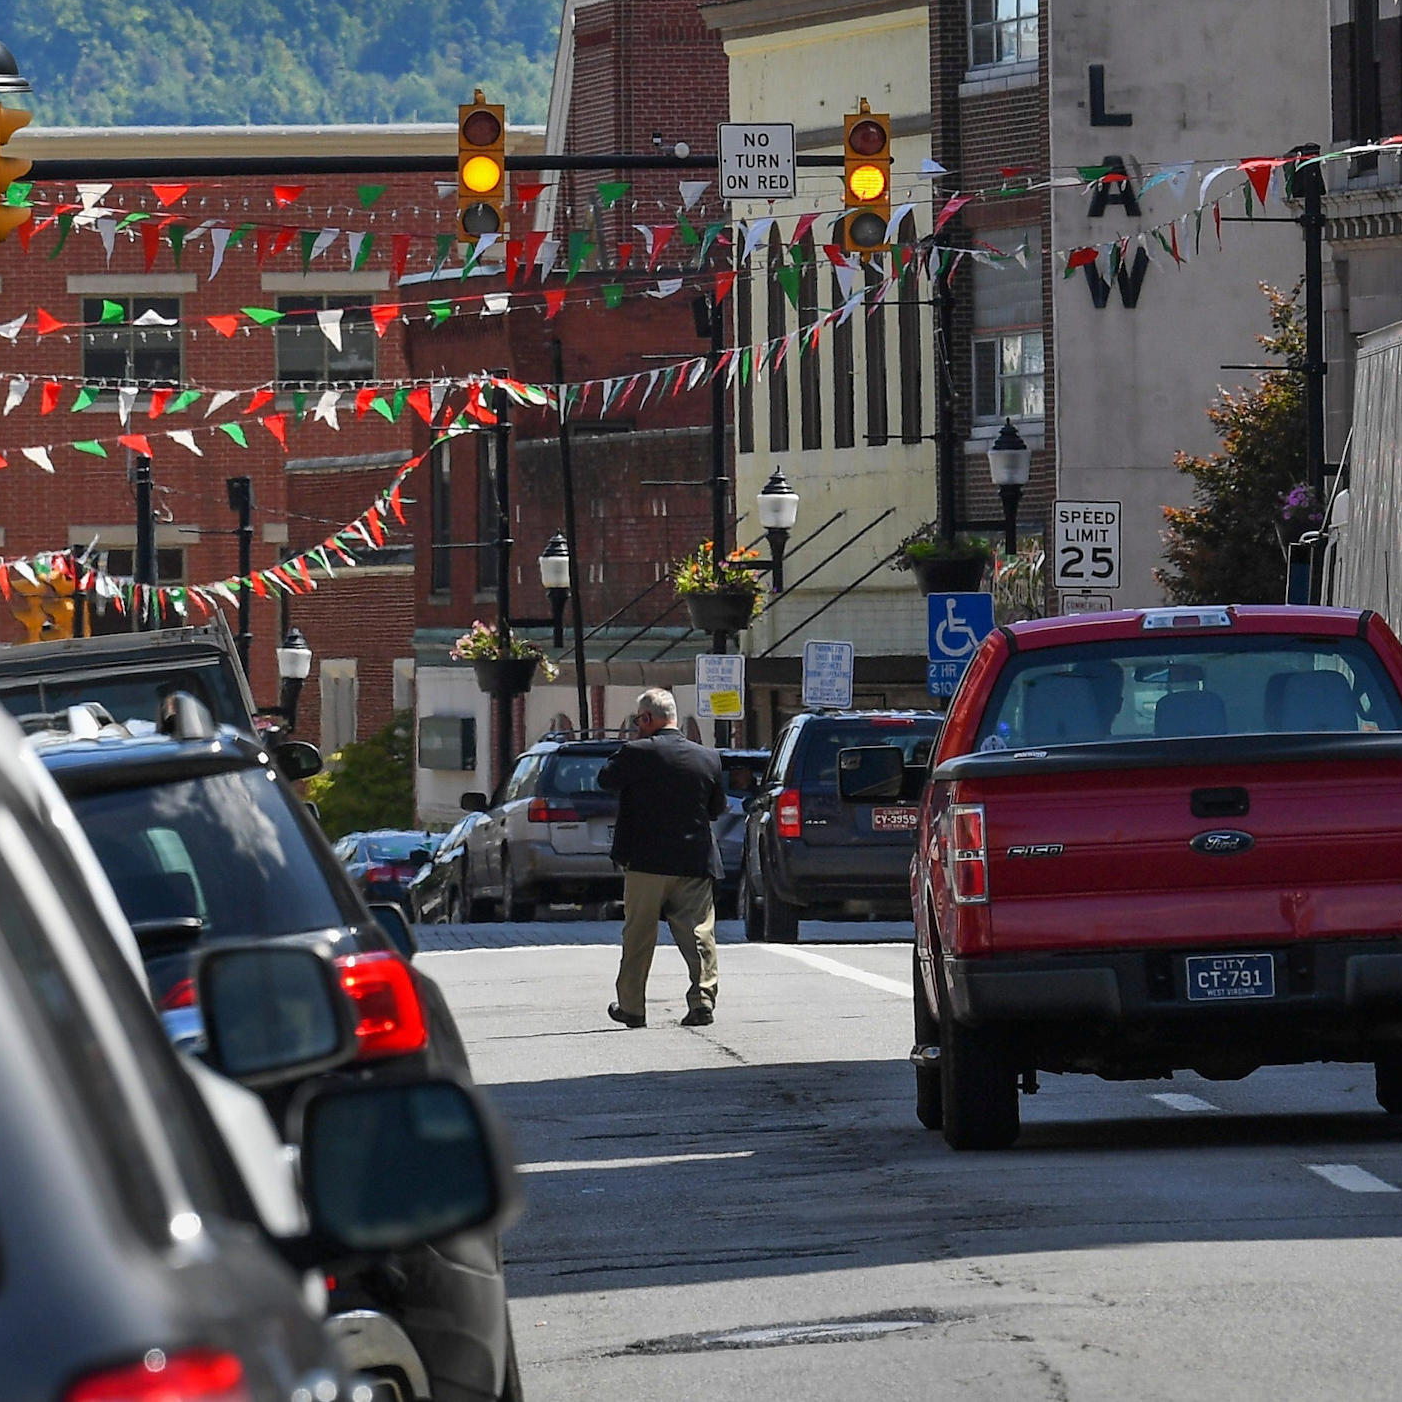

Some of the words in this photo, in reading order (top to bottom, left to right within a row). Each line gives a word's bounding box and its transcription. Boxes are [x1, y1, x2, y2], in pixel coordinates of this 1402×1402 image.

[743, 133, 769, 147] NO
[735, 154, 779, 168] TURN
[727, 175, 748, 189] ON
[758, 175, 789, 189] RED
[1081, 63, 1150, 310] LAW
[1059, 511, 1115, 524] SPEED
[1065, 529, 1109, 542] LIMIT
[1060, 546, 1114, 578] 25
[929, 665, 936, 677] 2
[941, 664, 957, 677] HR
[875, 815, 917, 825] CY-3959
[1204, 834, 1240, 851] Ford
[1213, 959, 1246, 970] CITY
[1197, 969, 1263, 989] CT-791
